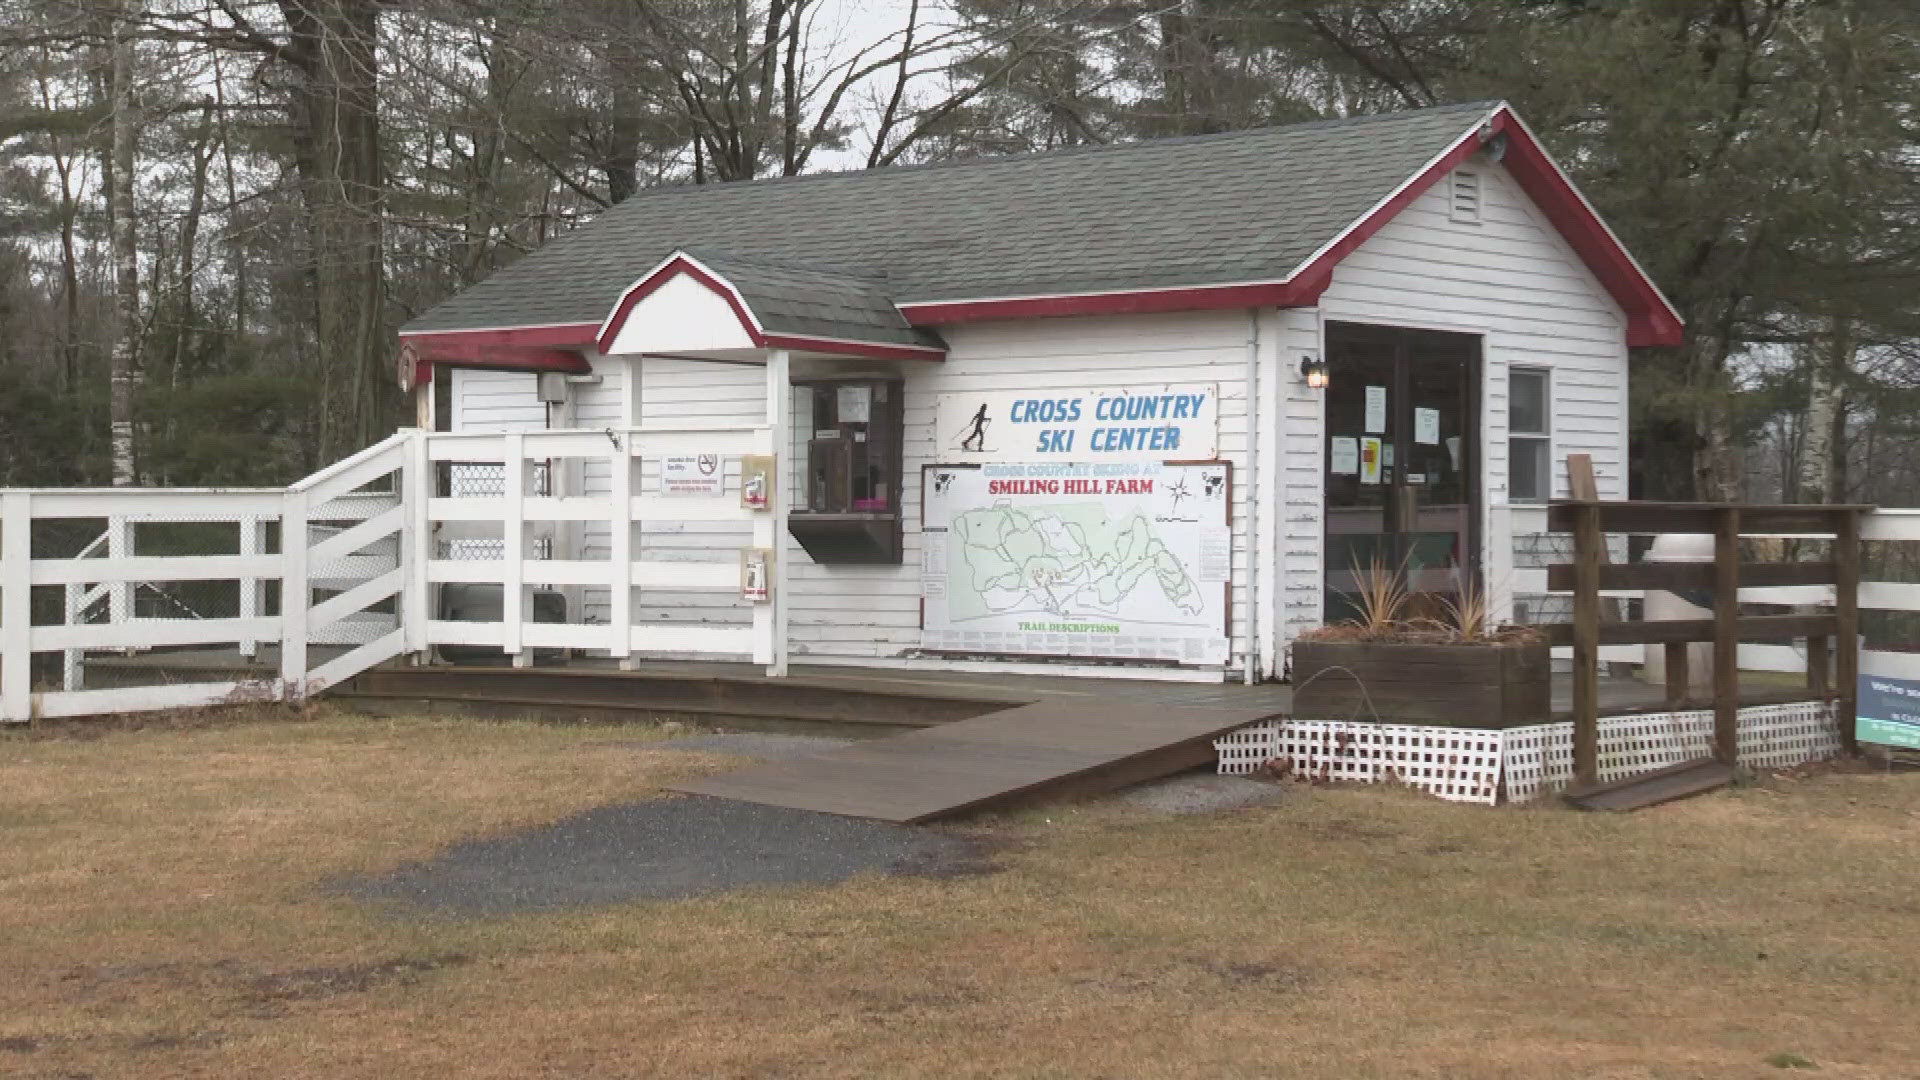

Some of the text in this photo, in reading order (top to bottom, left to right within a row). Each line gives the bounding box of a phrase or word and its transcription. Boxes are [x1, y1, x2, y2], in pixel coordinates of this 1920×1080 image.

[1010, 394, 1205, 423] CROSS COUNTRY
[1036, 426, 1181, 452] SKI CENTER
[988, 479, 1154, 495] SMILING HILL FARM
[1017, 622, 1120, 633] TRAIL DESCRIPTIONS
